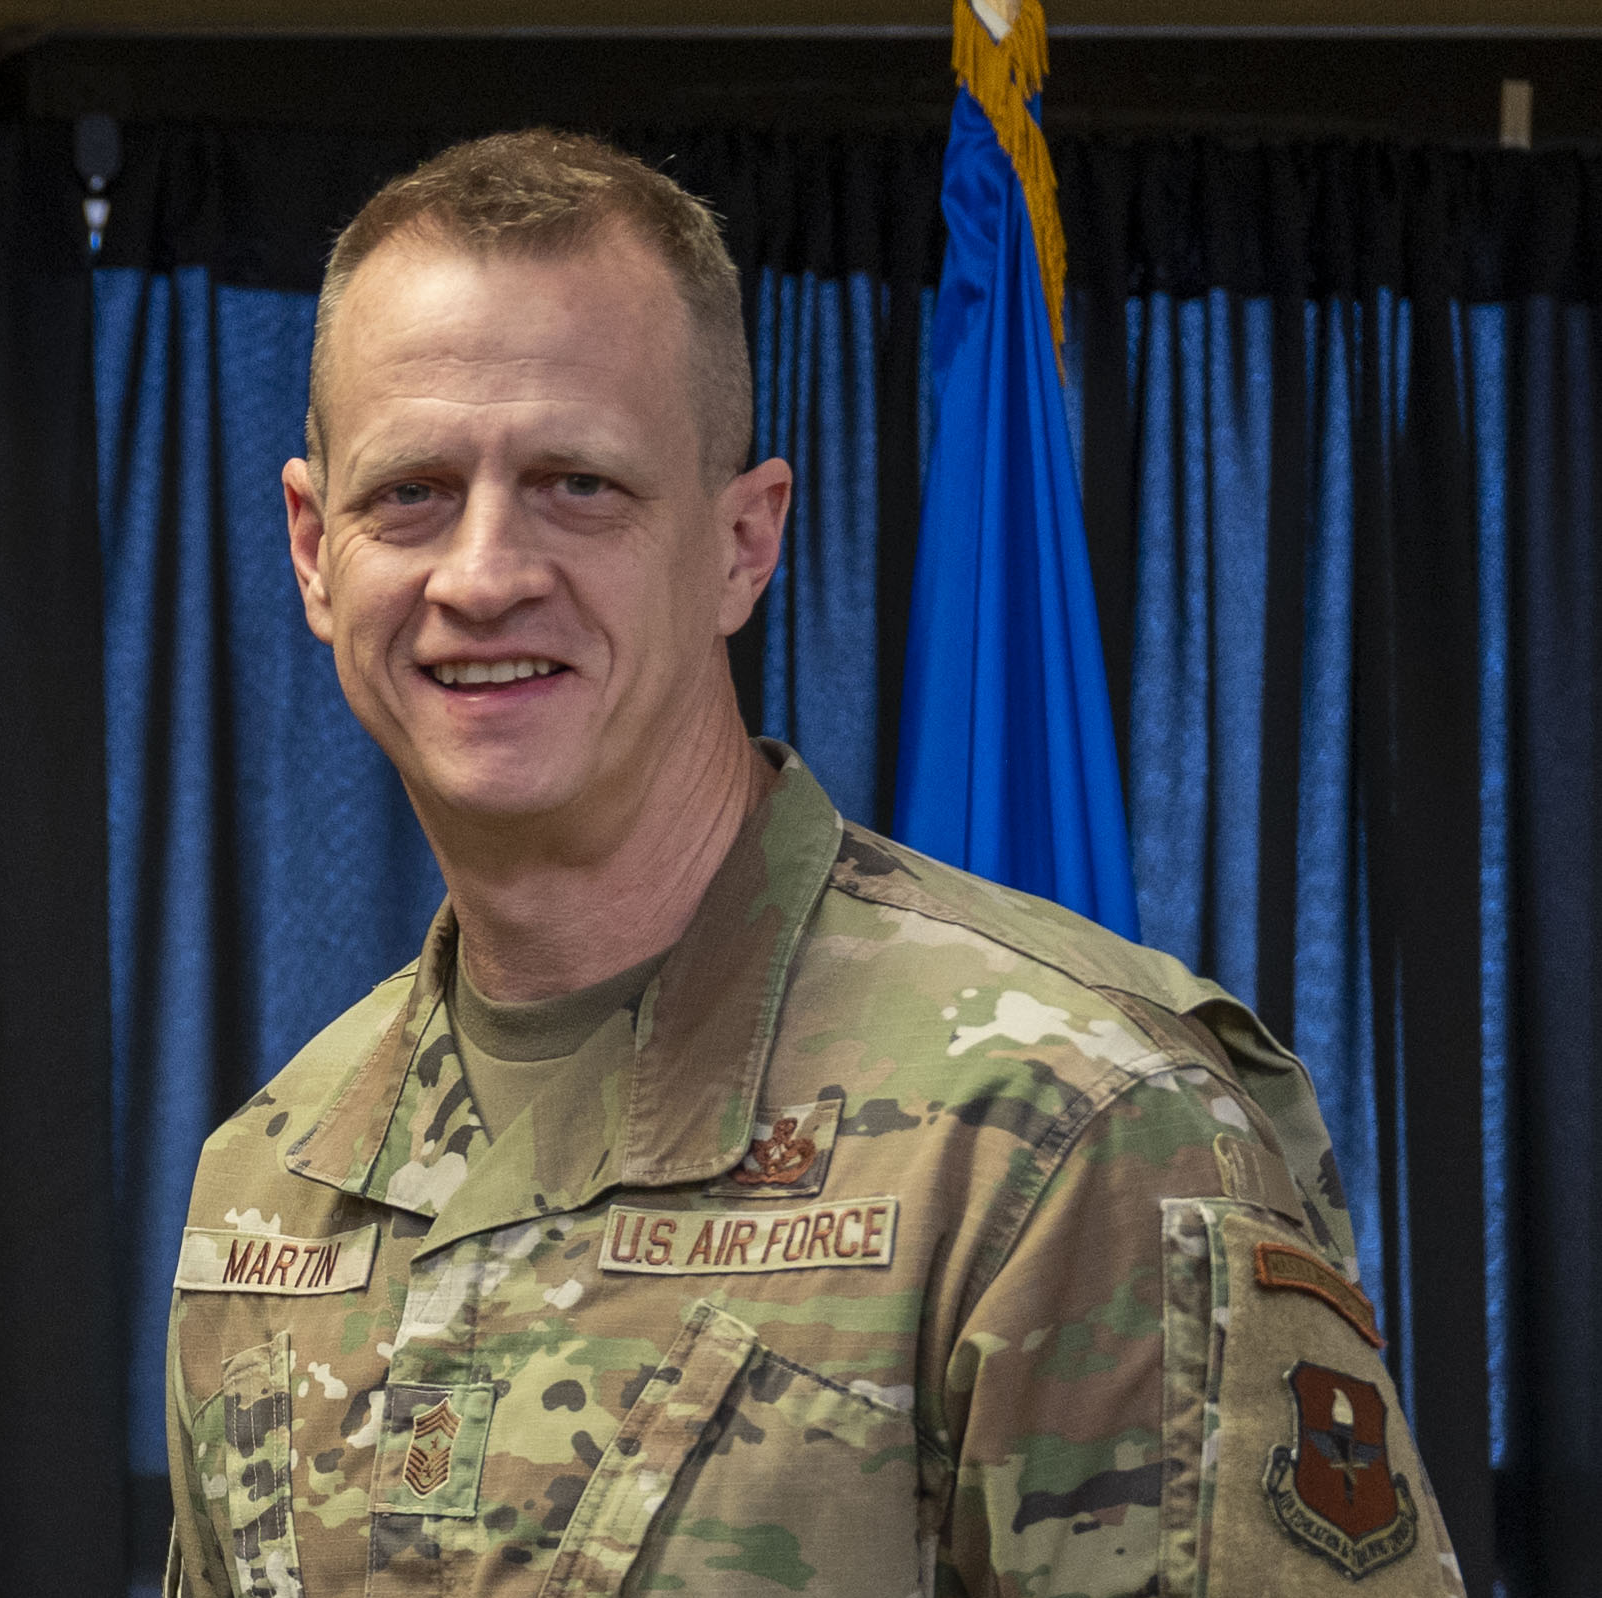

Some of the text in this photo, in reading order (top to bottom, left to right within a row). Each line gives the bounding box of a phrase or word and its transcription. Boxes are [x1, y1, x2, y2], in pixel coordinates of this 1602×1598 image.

[611, 1205, 887, 1266] U.S. AIR FORCE
[222, 1239, 342, 1288] MARTIN
